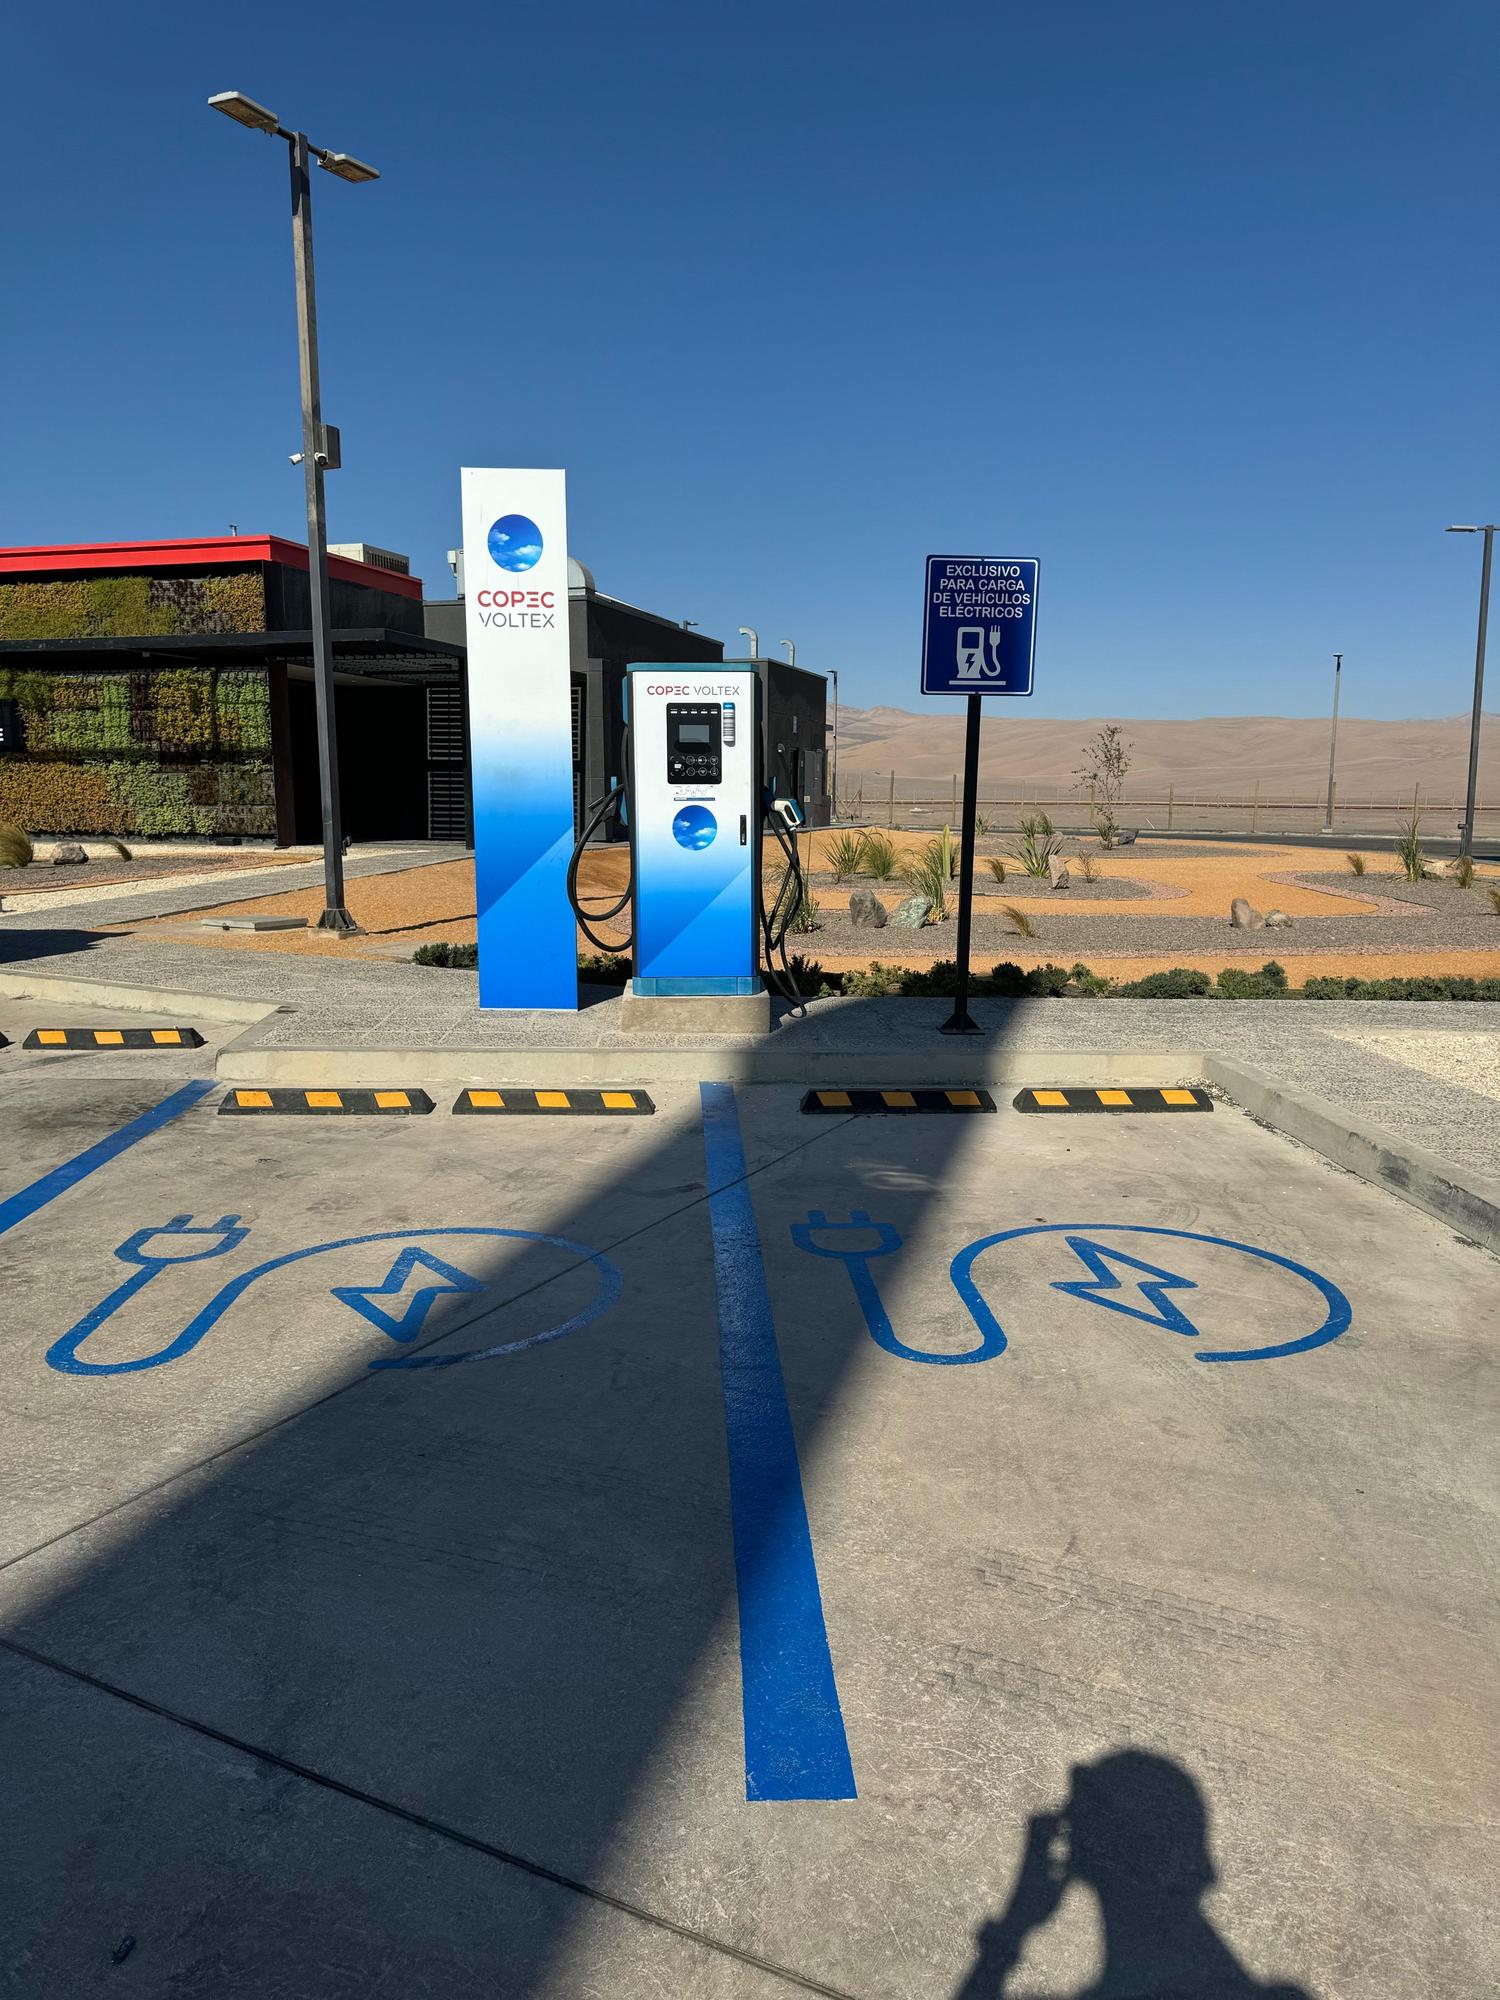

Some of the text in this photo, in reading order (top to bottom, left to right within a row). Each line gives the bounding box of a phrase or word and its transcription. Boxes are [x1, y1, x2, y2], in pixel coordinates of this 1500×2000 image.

[946, 565, 1020, 577] EXCLUSIVO
[940, 579, 1025, 591] PARA CARGA
[478, 590, 554, 608] COPEC
[933, 591, 1031, 605] DE VEHÍCULOS
[939, 604, 1023, 618] ELÉCTRICOS
[478, 612, 555, 628] VOLTEX
[646, 685, 740, 696] COPEC VOLTEX
